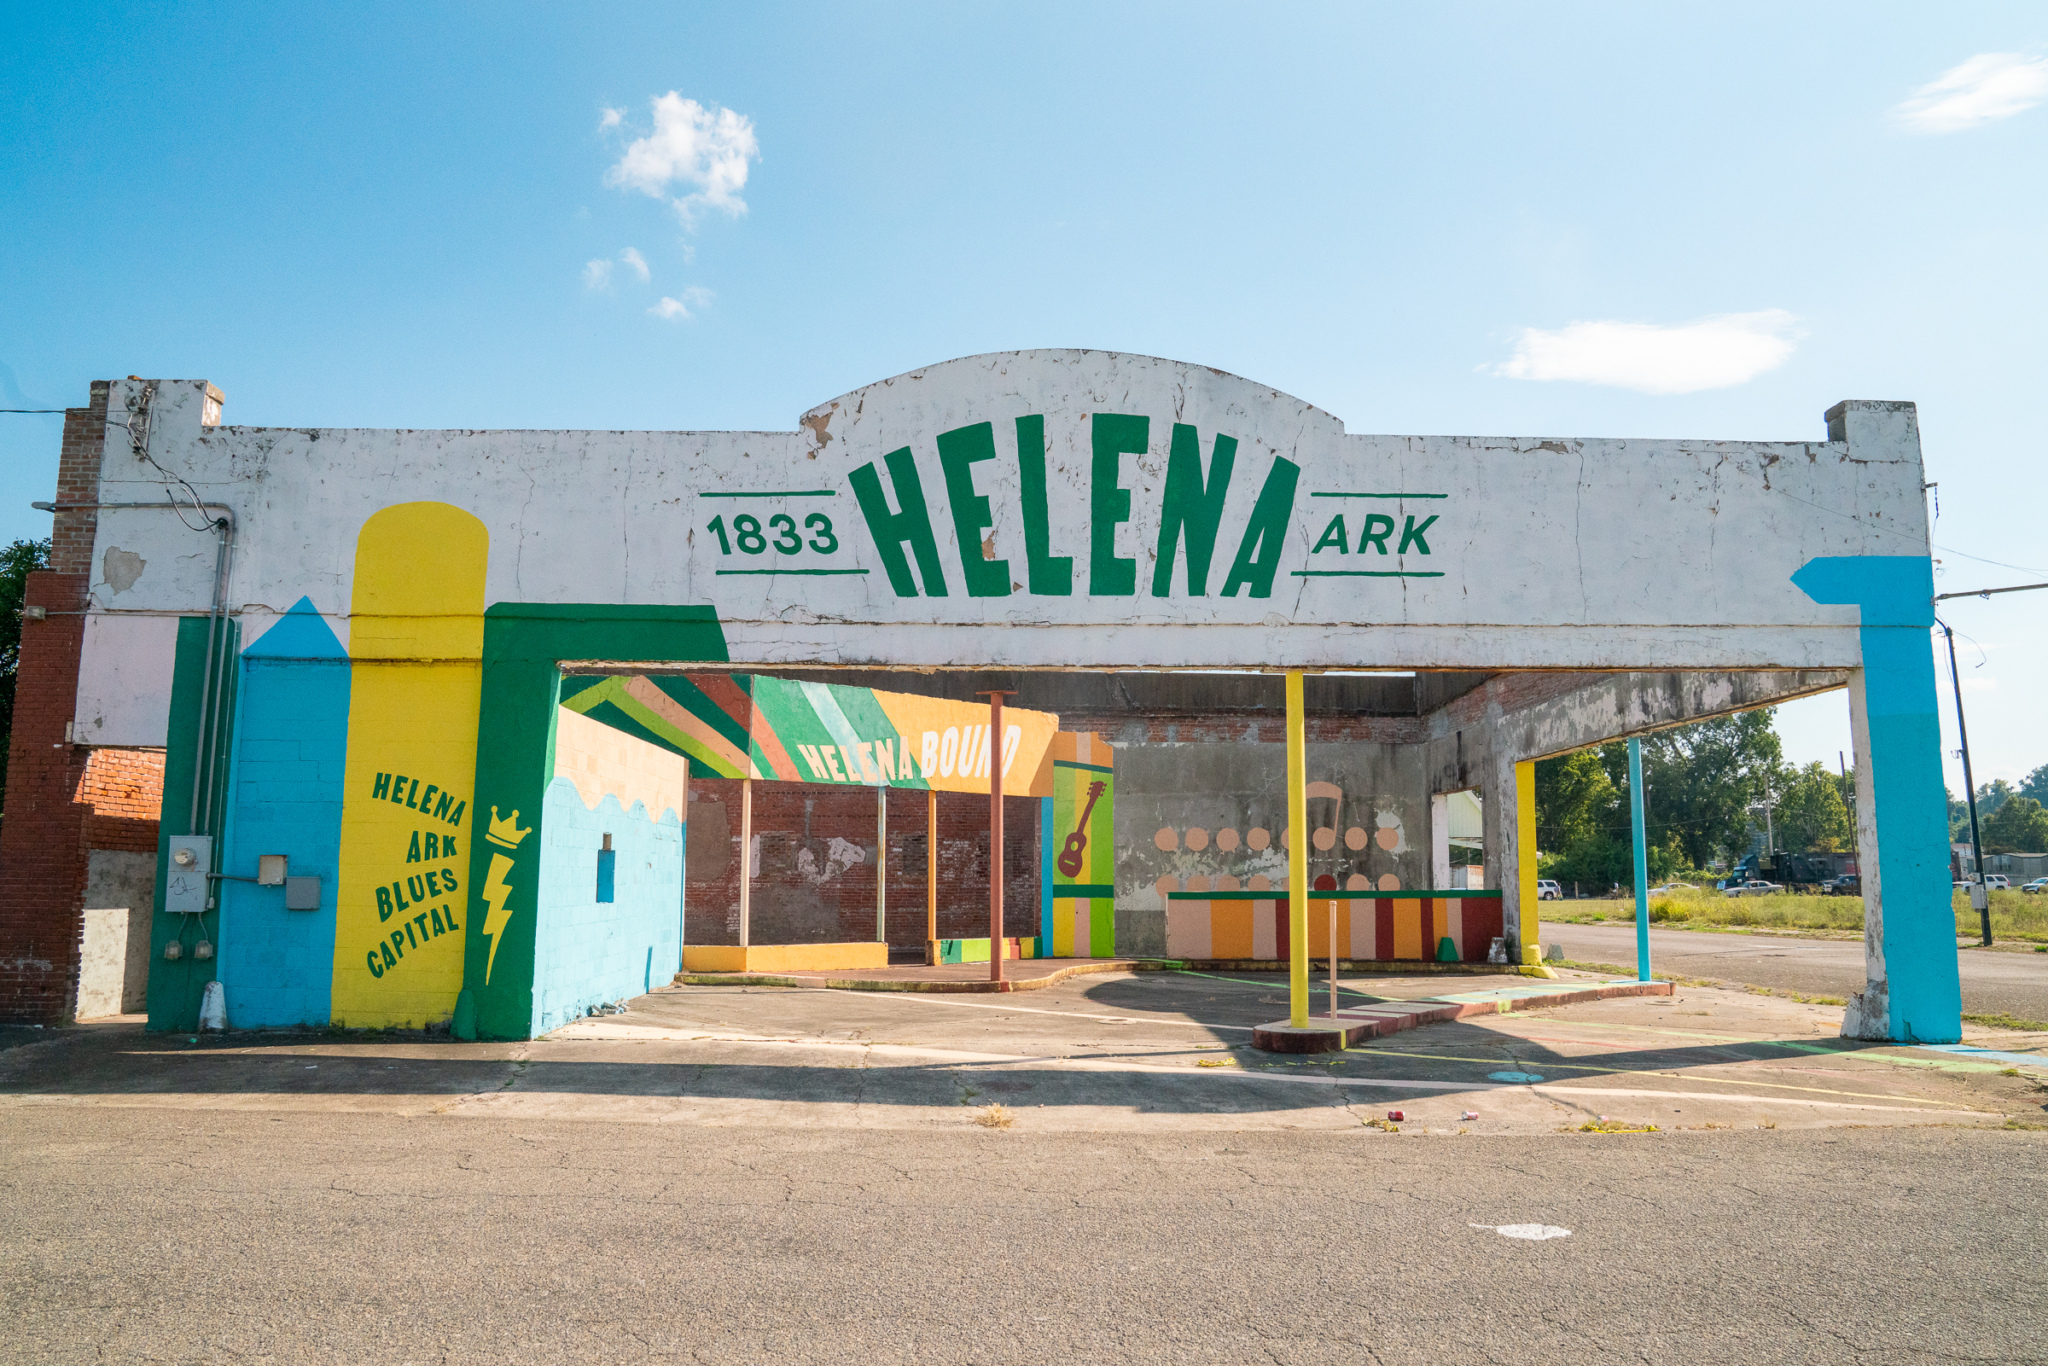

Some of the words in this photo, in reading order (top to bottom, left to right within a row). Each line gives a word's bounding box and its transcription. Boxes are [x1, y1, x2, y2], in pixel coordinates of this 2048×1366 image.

[706, 512, 840, 556] 1833
[847, 412, 1301, 599] HELENA
[1311, 514, 1440, 556] ARK
[797, 736, 914, 782] HELENA
[372, 772, 467, 827] HELENA
[406, 830, 458, 864] ARK
[375, 868, 458, 923] BLUES
[367, 904, 460, 979] CAPITAL
